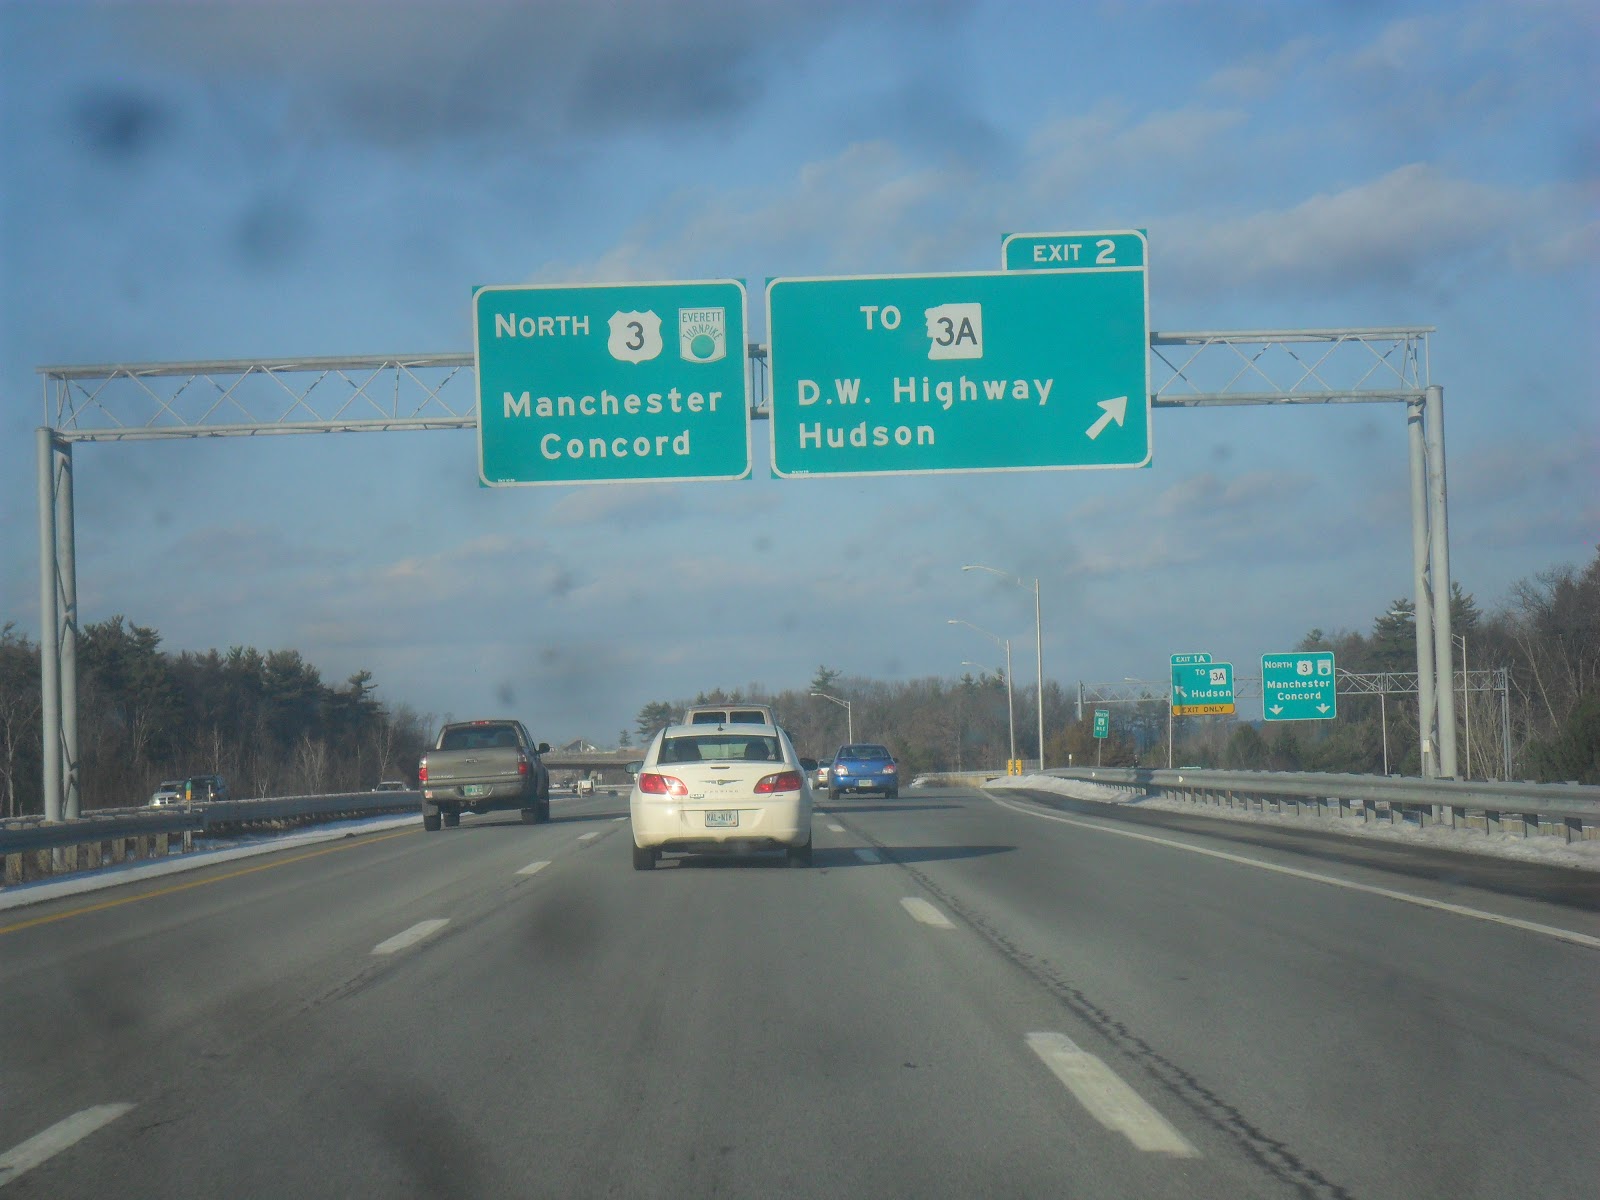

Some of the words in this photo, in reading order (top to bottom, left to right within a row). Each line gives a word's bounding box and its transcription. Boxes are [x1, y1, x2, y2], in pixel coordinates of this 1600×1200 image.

[1033, 243, 1083, 263] EXIT
[1095, 239, 1116, 265] 2
[682, 312, 721, 322] EVERETT
[495, 312, 590, 338] NORTH
[625, 321, 645, 351] 3
[682, 324, 723, 341] TURNPIKE
[859, 305, 902, 330] TO
[935, 316, 978, 347] 3A
[797, 378, 871, 406] D.W.
[893, 375, 1054, 411] Highway
[503, 387, 723, 418] Manchester
[799, 421, 935, 449] Hudson
[540, 429, 690, 460] Concord
[1194, 655, 1206, 663] 1A
[1264, 661, 1293, 669] NORTH
[1302, 663, 1308, 673] 3
[1212, 672, 1225, 681] 3A
[1267, 680, 1331, 689] Manchester
[1191, 689, 1232, 698] Hudson
[1277, 691, 1322, 700] Concord
[1203, 705, 1225, 713] ONLY
